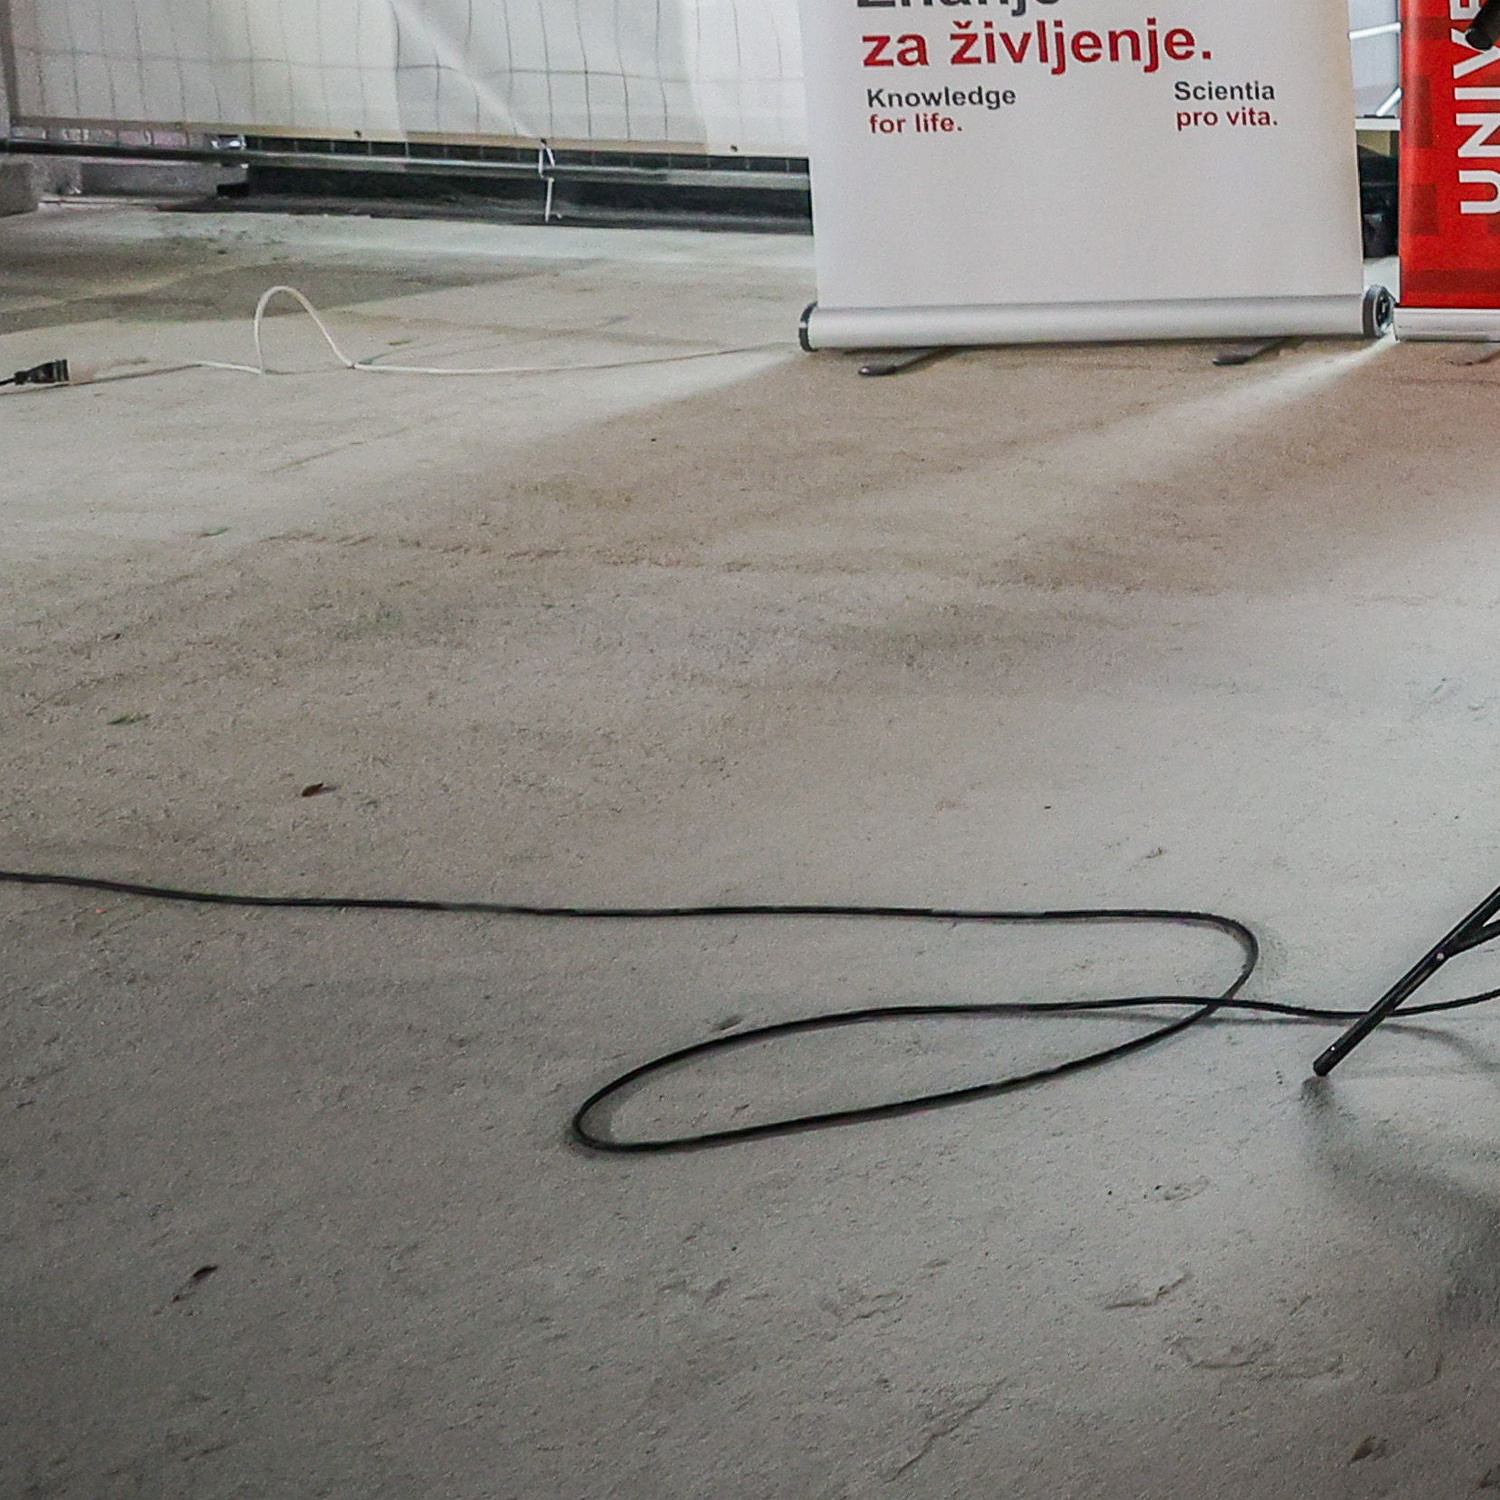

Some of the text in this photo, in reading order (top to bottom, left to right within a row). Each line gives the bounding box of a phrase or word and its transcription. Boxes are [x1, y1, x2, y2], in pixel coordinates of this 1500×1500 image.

[861, 18, 1212, 75] za življenje.
[866, 86, 1017, 110] Knowledge
[1174, 80, 1276, 101] Scientia
[869, 112, 963, 134] for life.
[1175, 108, 1278, 132] pro vita.
